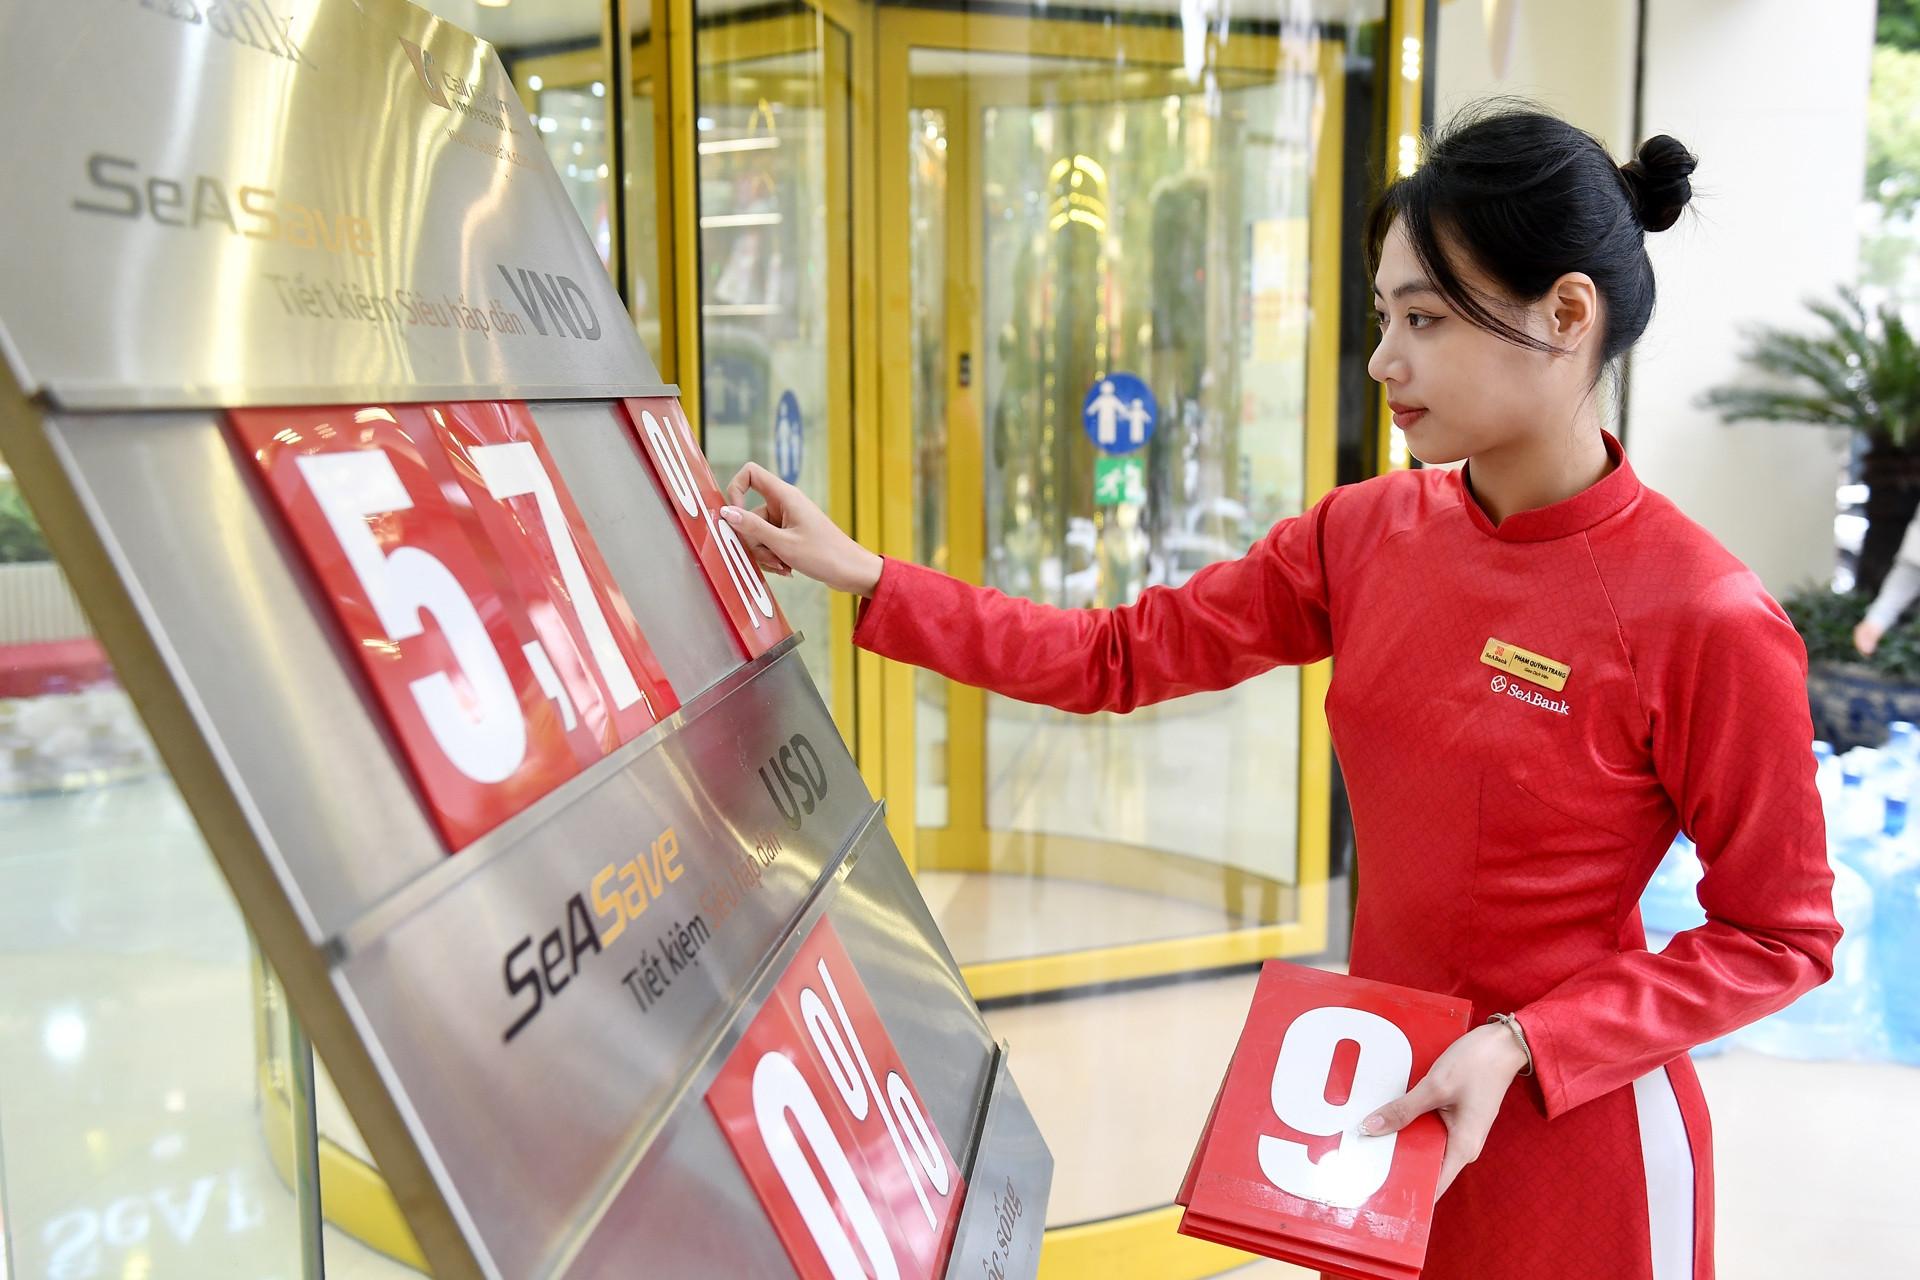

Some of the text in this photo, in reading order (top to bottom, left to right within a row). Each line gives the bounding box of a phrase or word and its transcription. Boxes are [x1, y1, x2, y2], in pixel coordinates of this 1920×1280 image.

[441, 70, 471, 98] Call
[71, 152, 377, 259] SeASave
[327, 278, 400, 330] kiệm
[395, 289, 449, 328] Siêu
[445, 293, 490, 340] hấp
[497, 263, 602, 341] VND
[1485, 652, 1508, 665] SeABank
[1547, 667, 1567, 679] TRANG
[1507, 683, 1570, 715] SeABank
[621, 948, 671, 1014] Tiết
[657, 914, 712, 977] kiệm
[700, 876, 739, 930] Siêu
[758, 733, 828, 832] USD
[502, 826, 685, 1045] SeASave
[1257, 1006, 1413, 1209] 9
